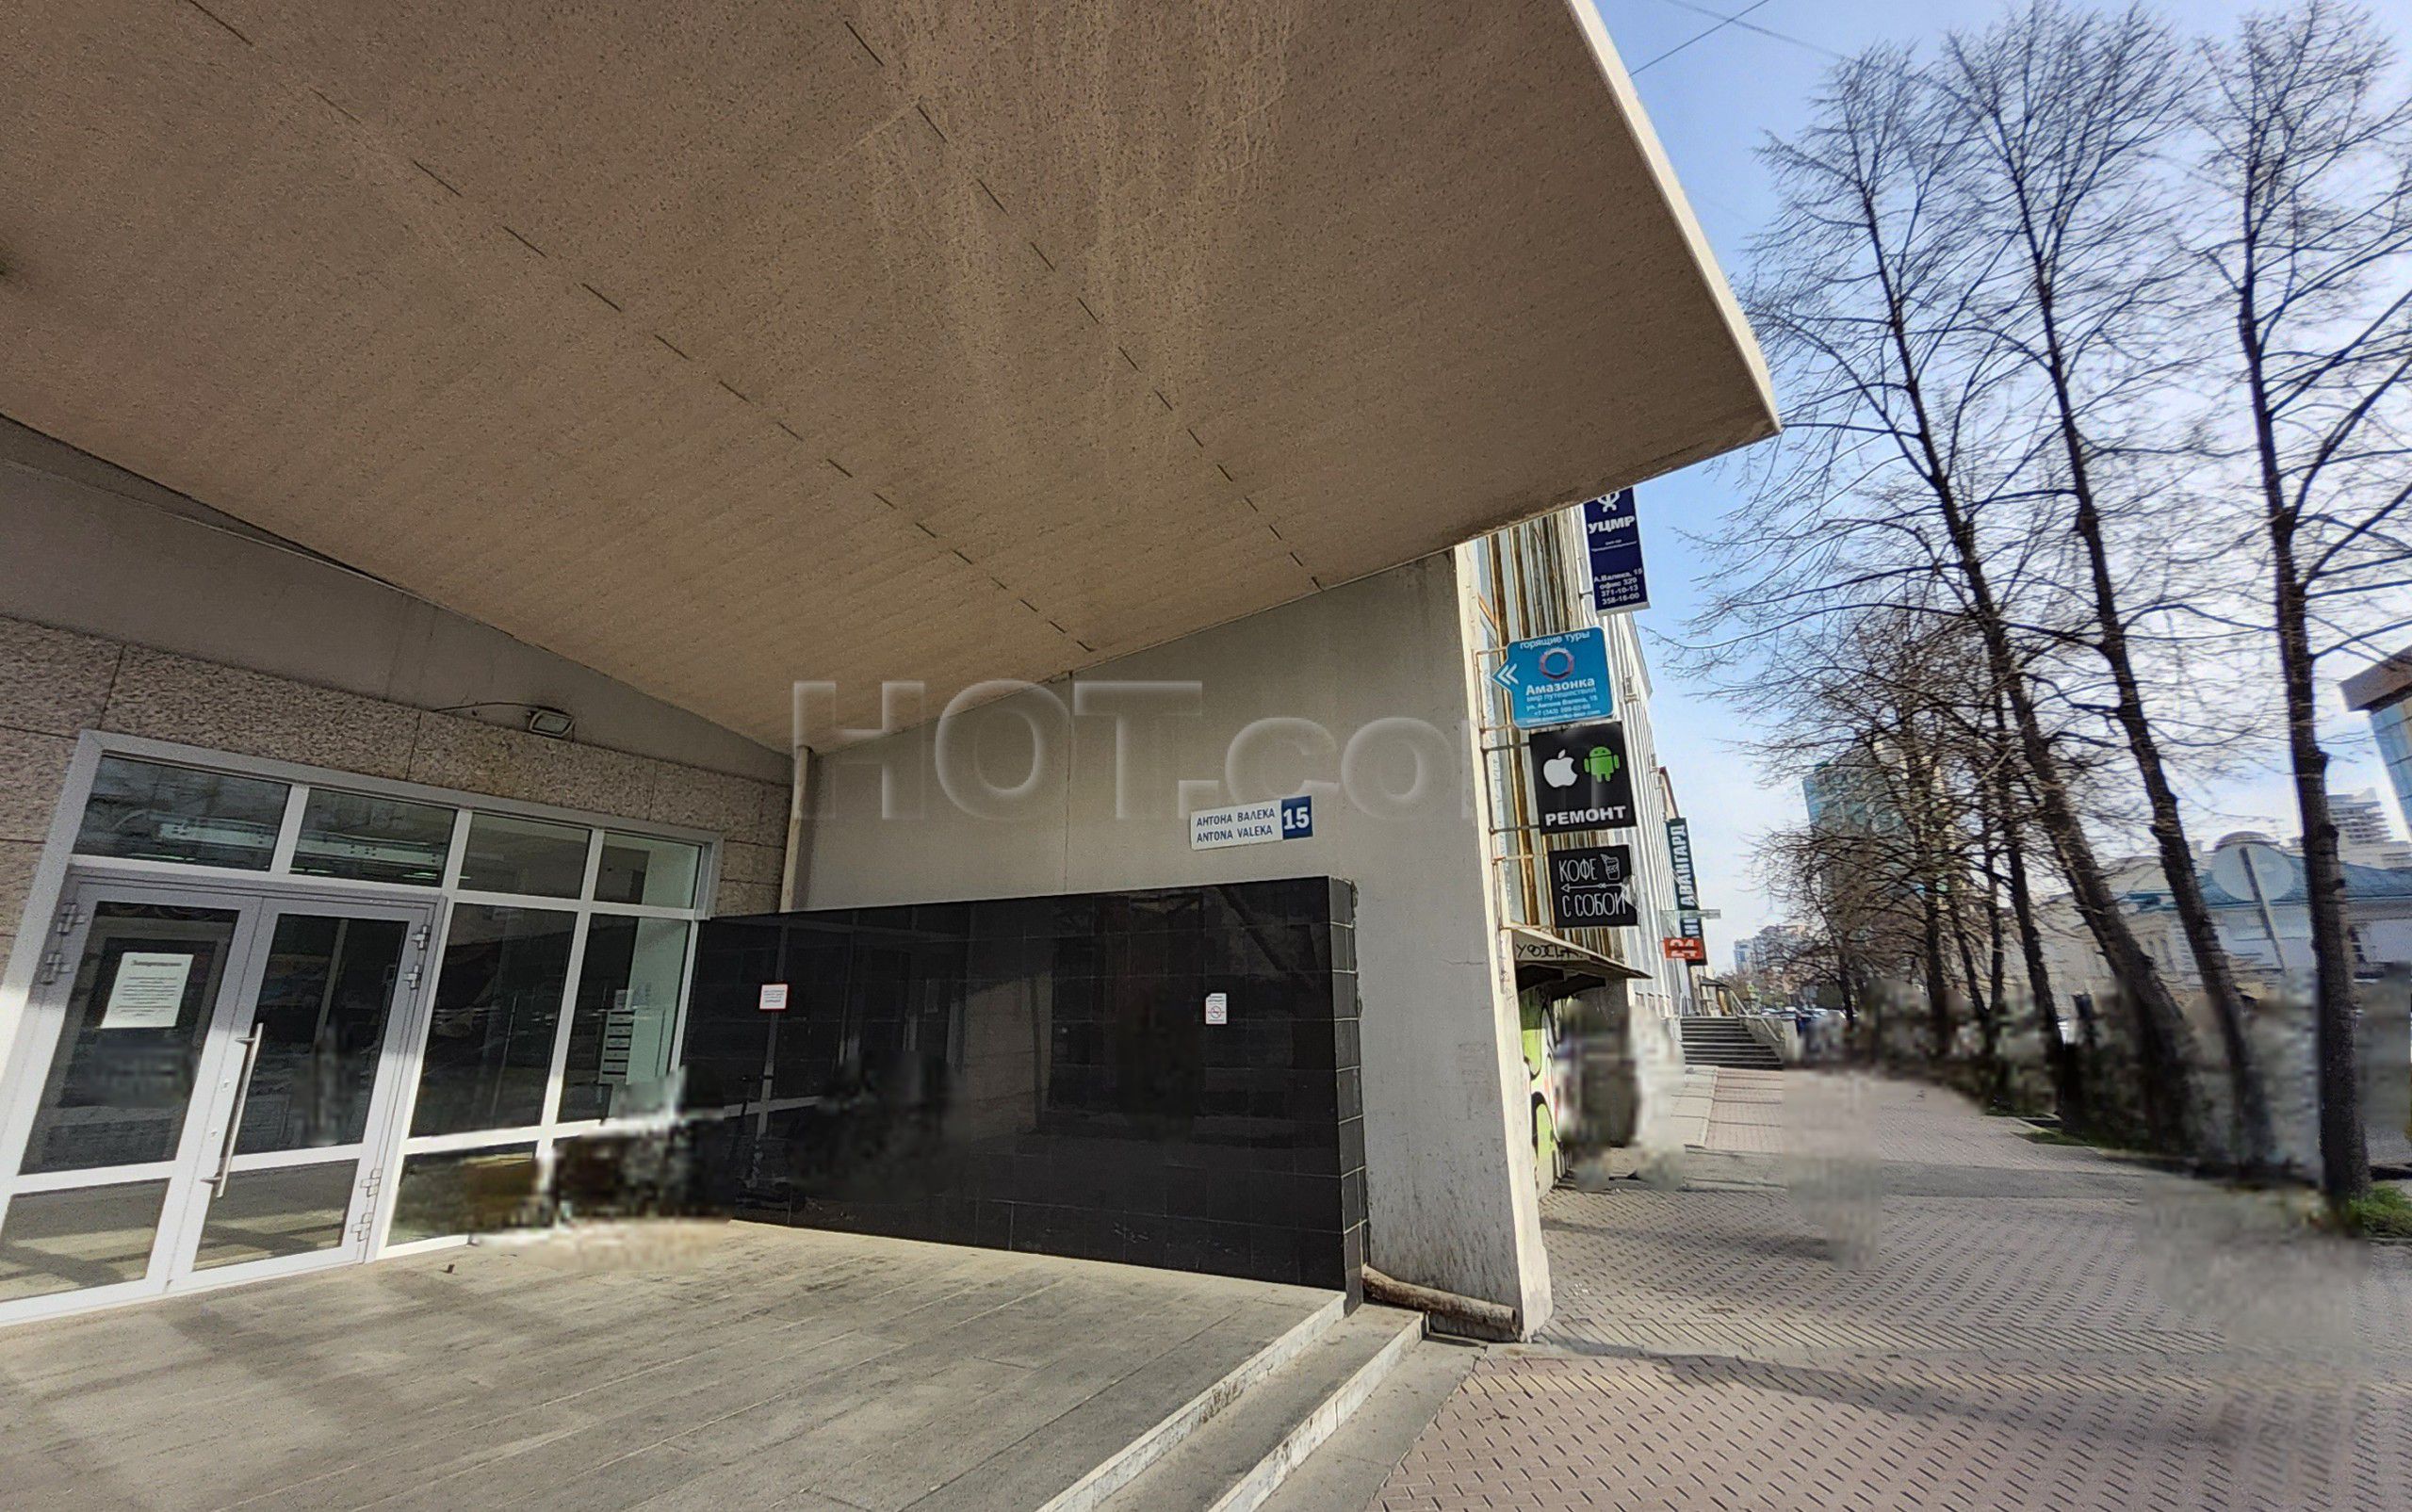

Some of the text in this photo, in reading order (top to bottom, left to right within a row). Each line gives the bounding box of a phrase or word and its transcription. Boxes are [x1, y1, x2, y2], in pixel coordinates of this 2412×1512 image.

[1588, 515, 1636, 534] УЦМР
[1520, 631, 1590, 650] горящие туры
[1525, 678, 1595, 695] Амазонка
[1197, 806, 1310, 830] АНТОНА ВАЛЕКА 15
[1545, 805, 1626, 826] РЕМОНТ
[1197, 824, 1273, 843] ANTONA VALEKA
[1558, 858, 1598, 883] КОФЕ
[1670, 824, 1695, 906] АВАНГАРД
[1562, 895, 1573, 918] С
